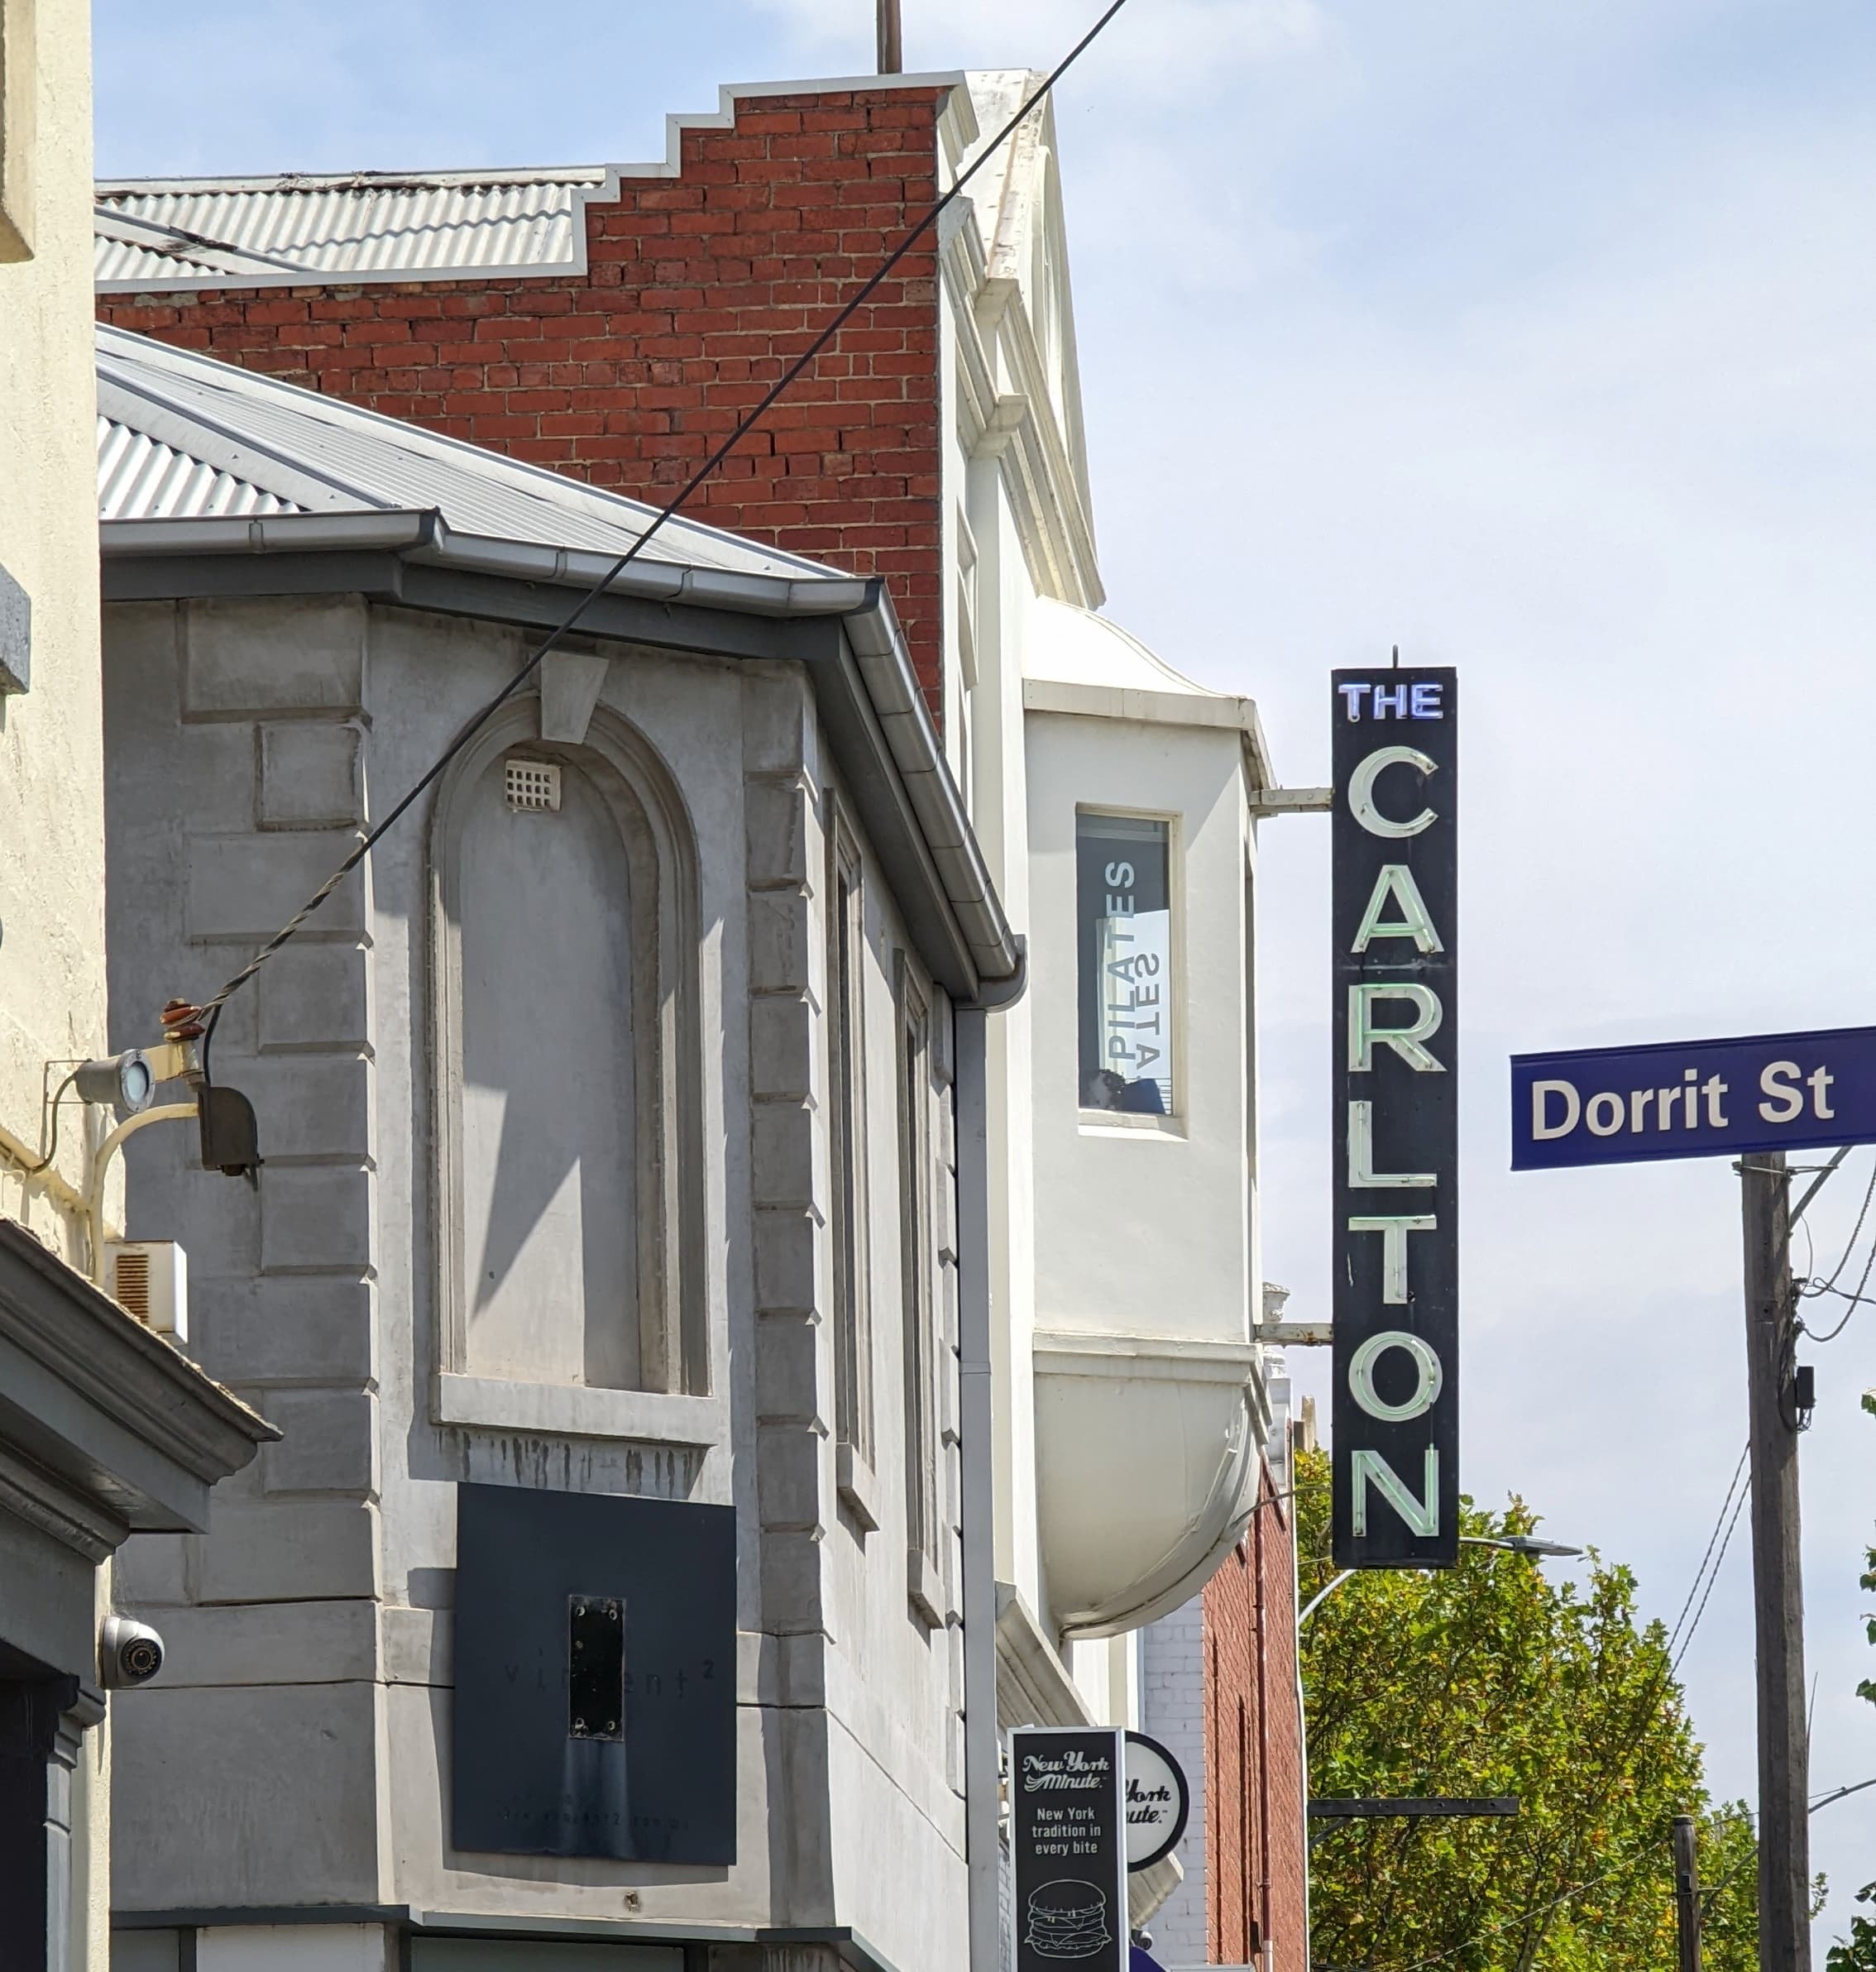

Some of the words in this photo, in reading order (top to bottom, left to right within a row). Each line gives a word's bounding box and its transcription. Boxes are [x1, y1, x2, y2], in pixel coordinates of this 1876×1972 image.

[1338, 683, 1443, 722] THE
[1104, 860, 1137, 1062] PILATES
[1532, 1068, 1729, 1141] Dorrit
[1758, 1060, 1835, 1123] St
[1347, 744, 1448, 1537] CARLTON
[1022, 1754, 1065, 1773] New
[1063, 1750, 1110, 1772] York
[1036, 1807, 1064, 1821] New
[1067, 1807, 1095, 1820] York
[1031, 1824, 1087, 1838] tradition
[1089, 1823, 1102, 1836] in
[1035, 1842, 1070, 1856] every
[1073, 1840, 1098, 1854] bite
